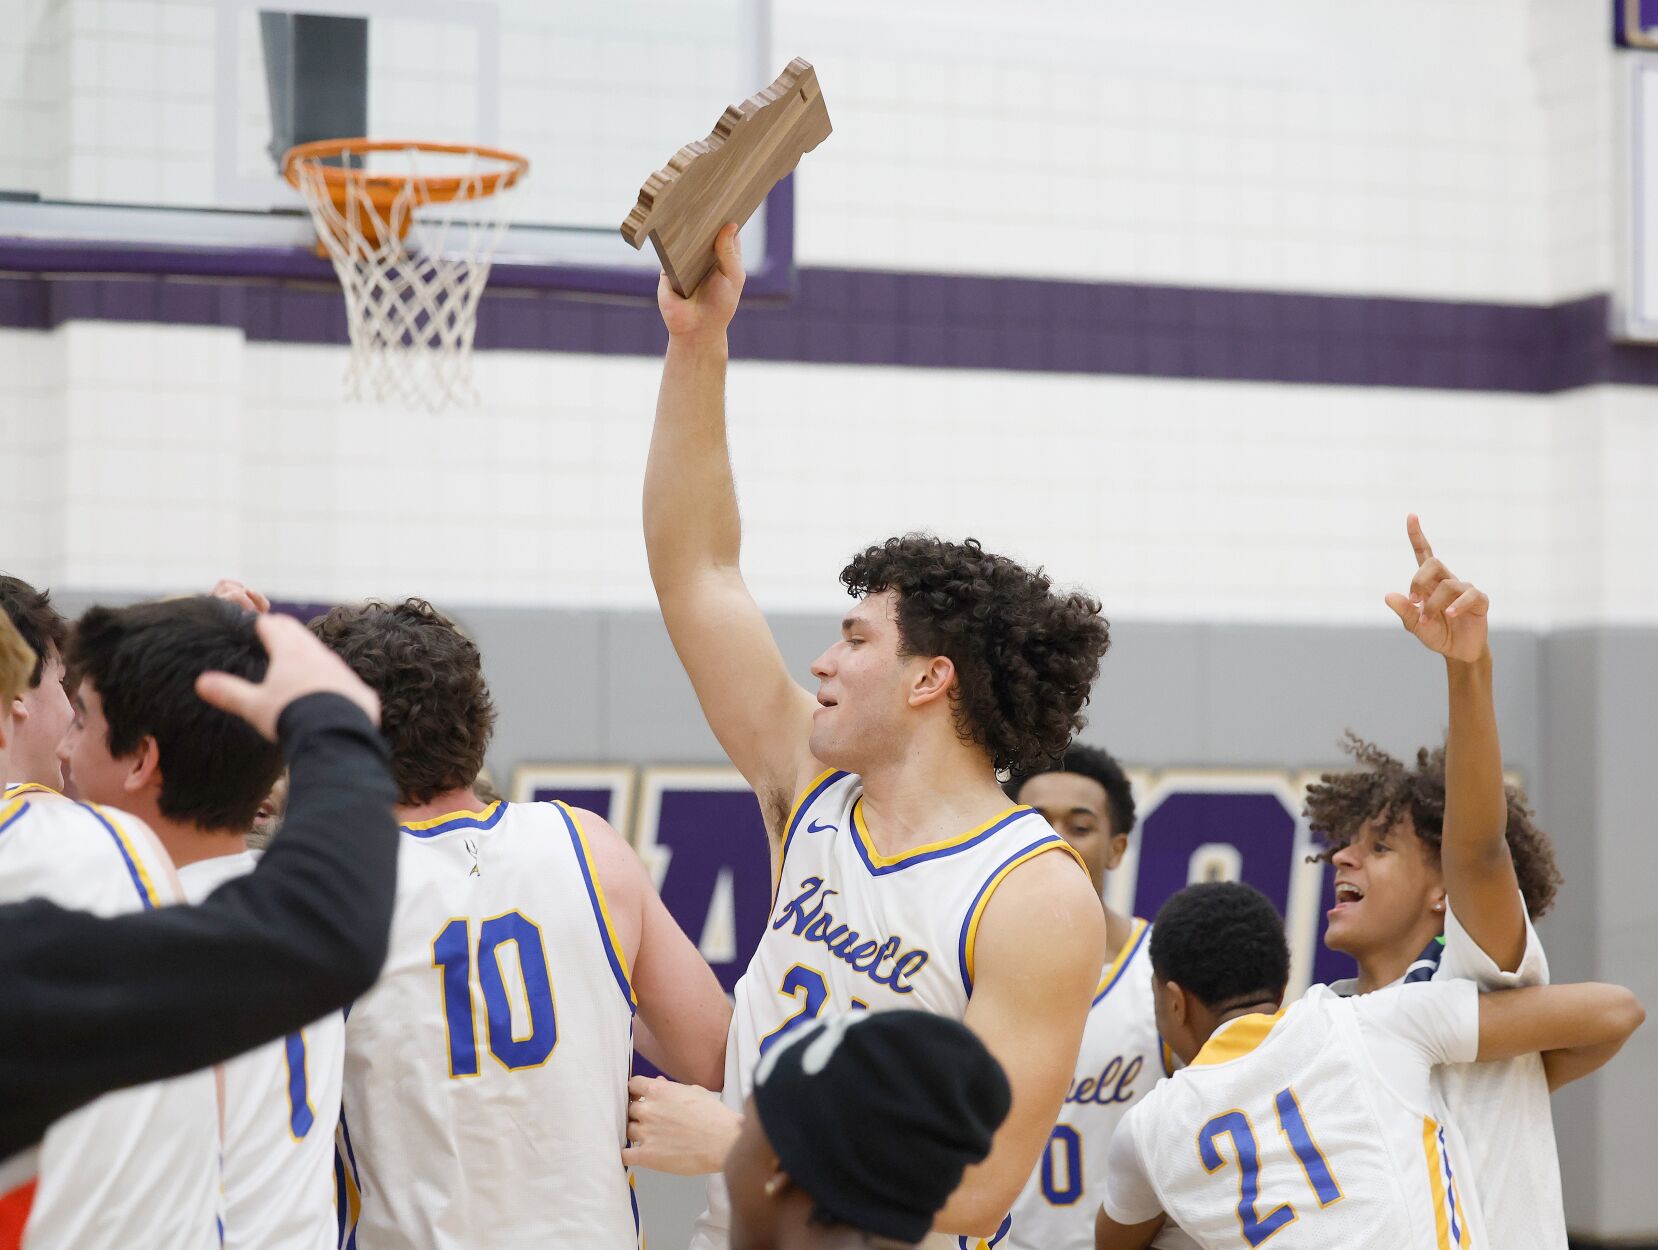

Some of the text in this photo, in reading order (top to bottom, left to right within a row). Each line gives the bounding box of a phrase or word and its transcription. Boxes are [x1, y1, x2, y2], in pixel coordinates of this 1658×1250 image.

[431, 907, 560, 1079] 10
[772, 875, 930, 994] Howell
[758, 961, 870, 1060] 2
[1064, 1054, 1144, 1105] ell
[1194, 1084, 1345, 1250] 21
